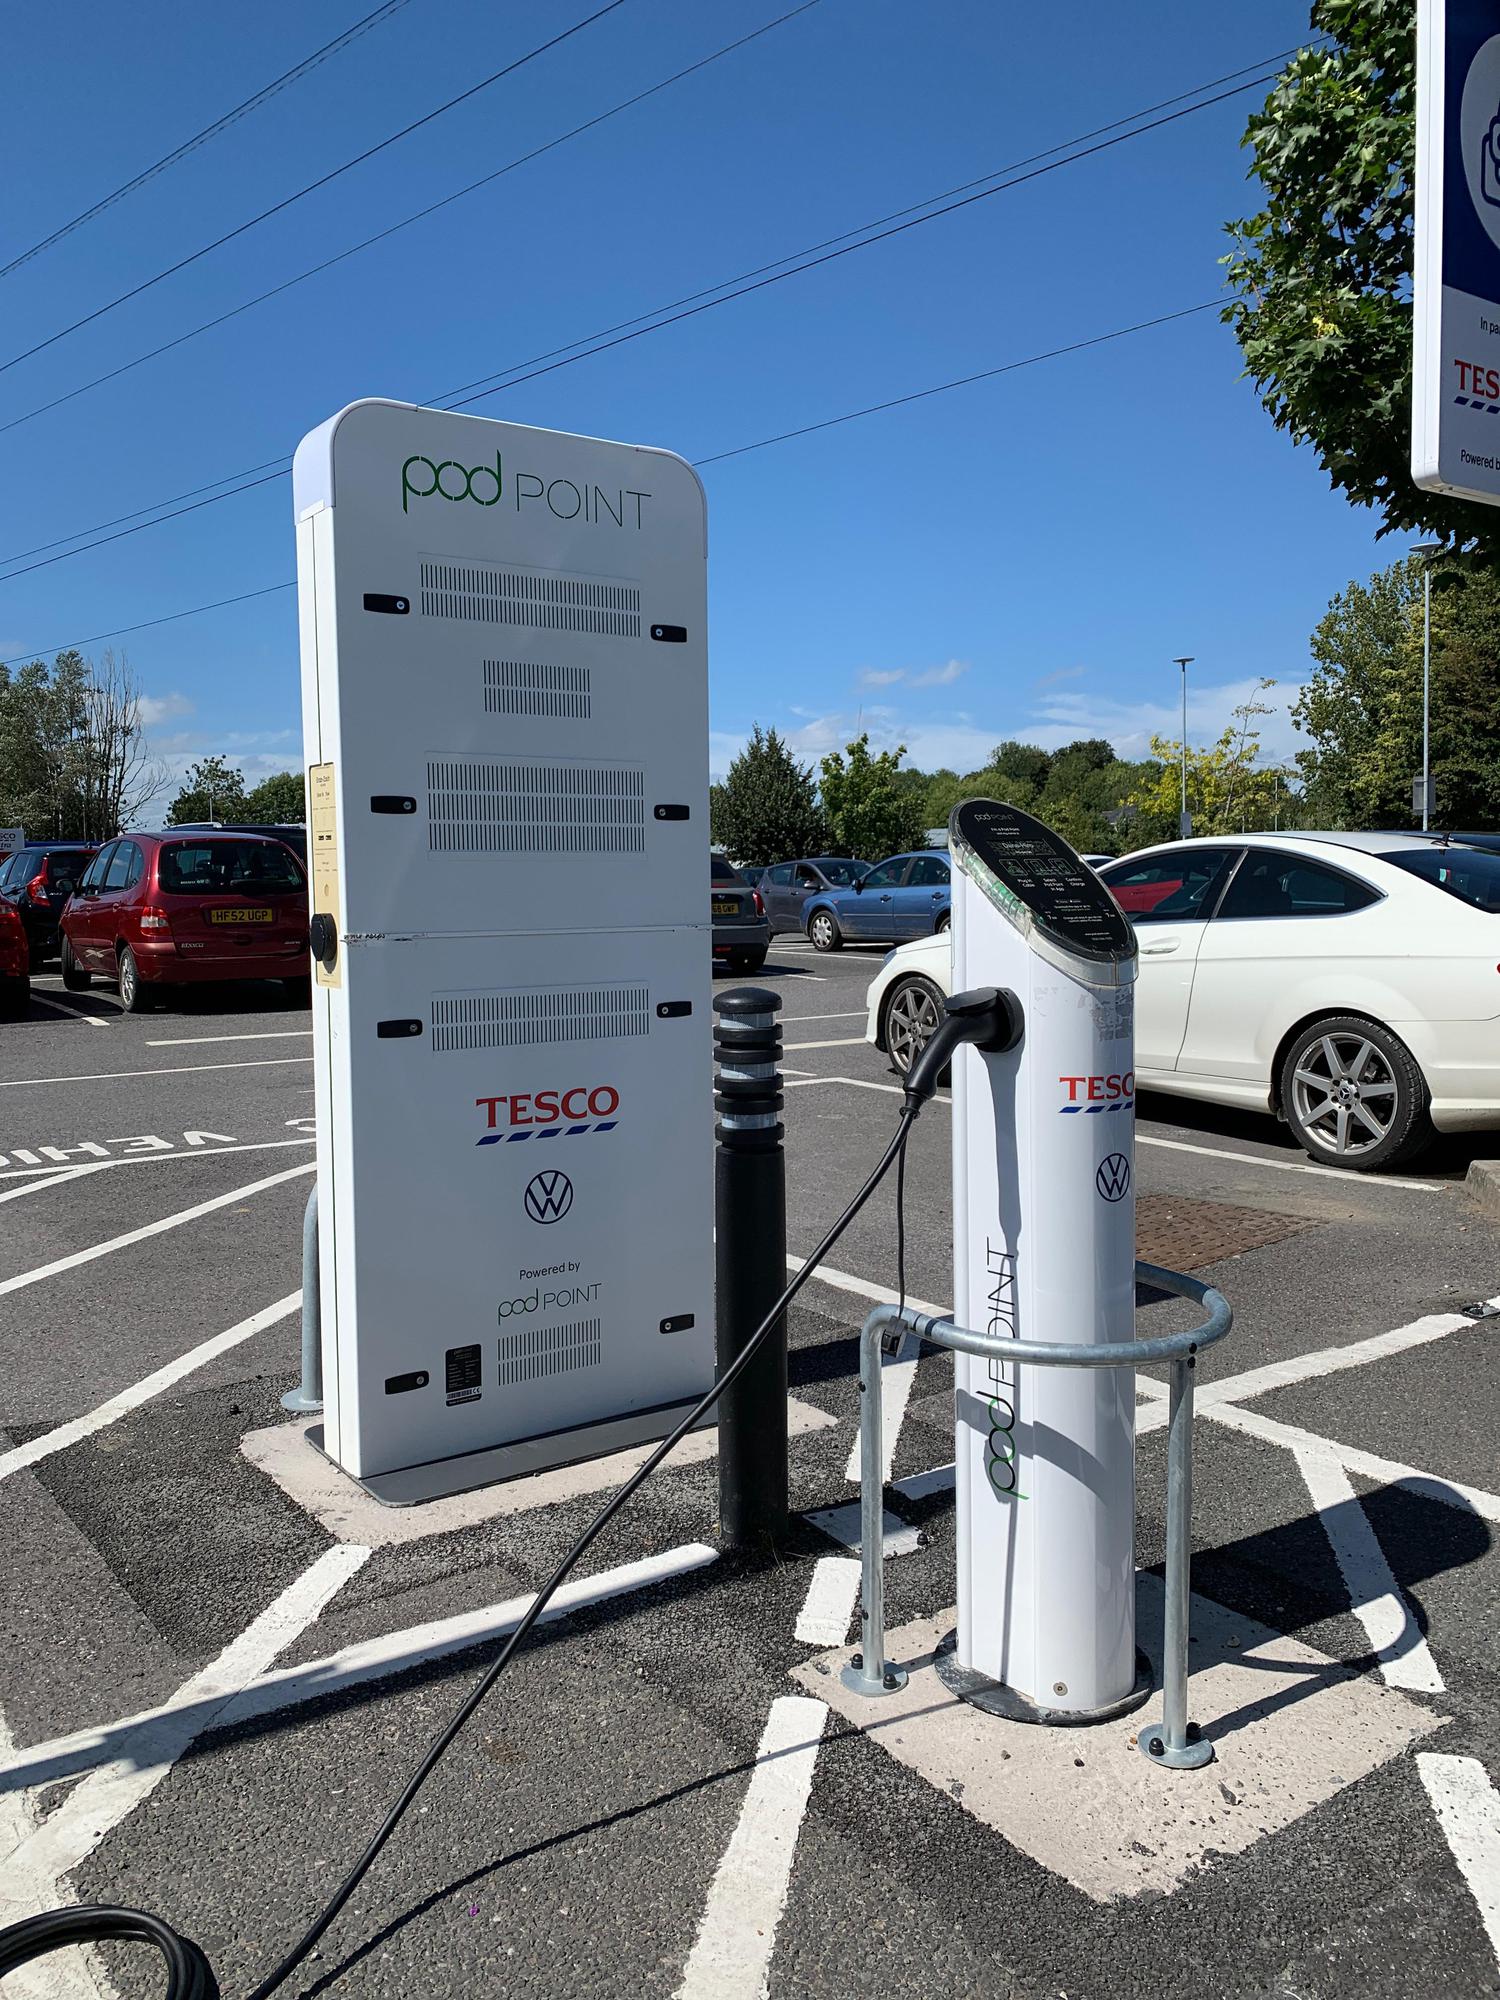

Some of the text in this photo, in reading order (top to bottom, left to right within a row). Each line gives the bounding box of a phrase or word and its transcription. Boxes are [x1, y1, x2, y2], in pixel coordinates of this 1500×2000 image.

[1480, 316, 1500, 336] In pa
[1454, 359, 1500, 400] TES
[1460, 449, 1494, 469] Powered
[402, 449, 652, 530] pod POINT
[216, 910, 269, 921] HF52 UGP
[1059, 1072, 1135, 1101] TESC
[475, 1086, 620, 1128] TESCO
[519, 1261, 581, 1280] Powered by
[498, 1283, 602, 1326] pod POINT
[976, 1390, 1029, 1500] pod
